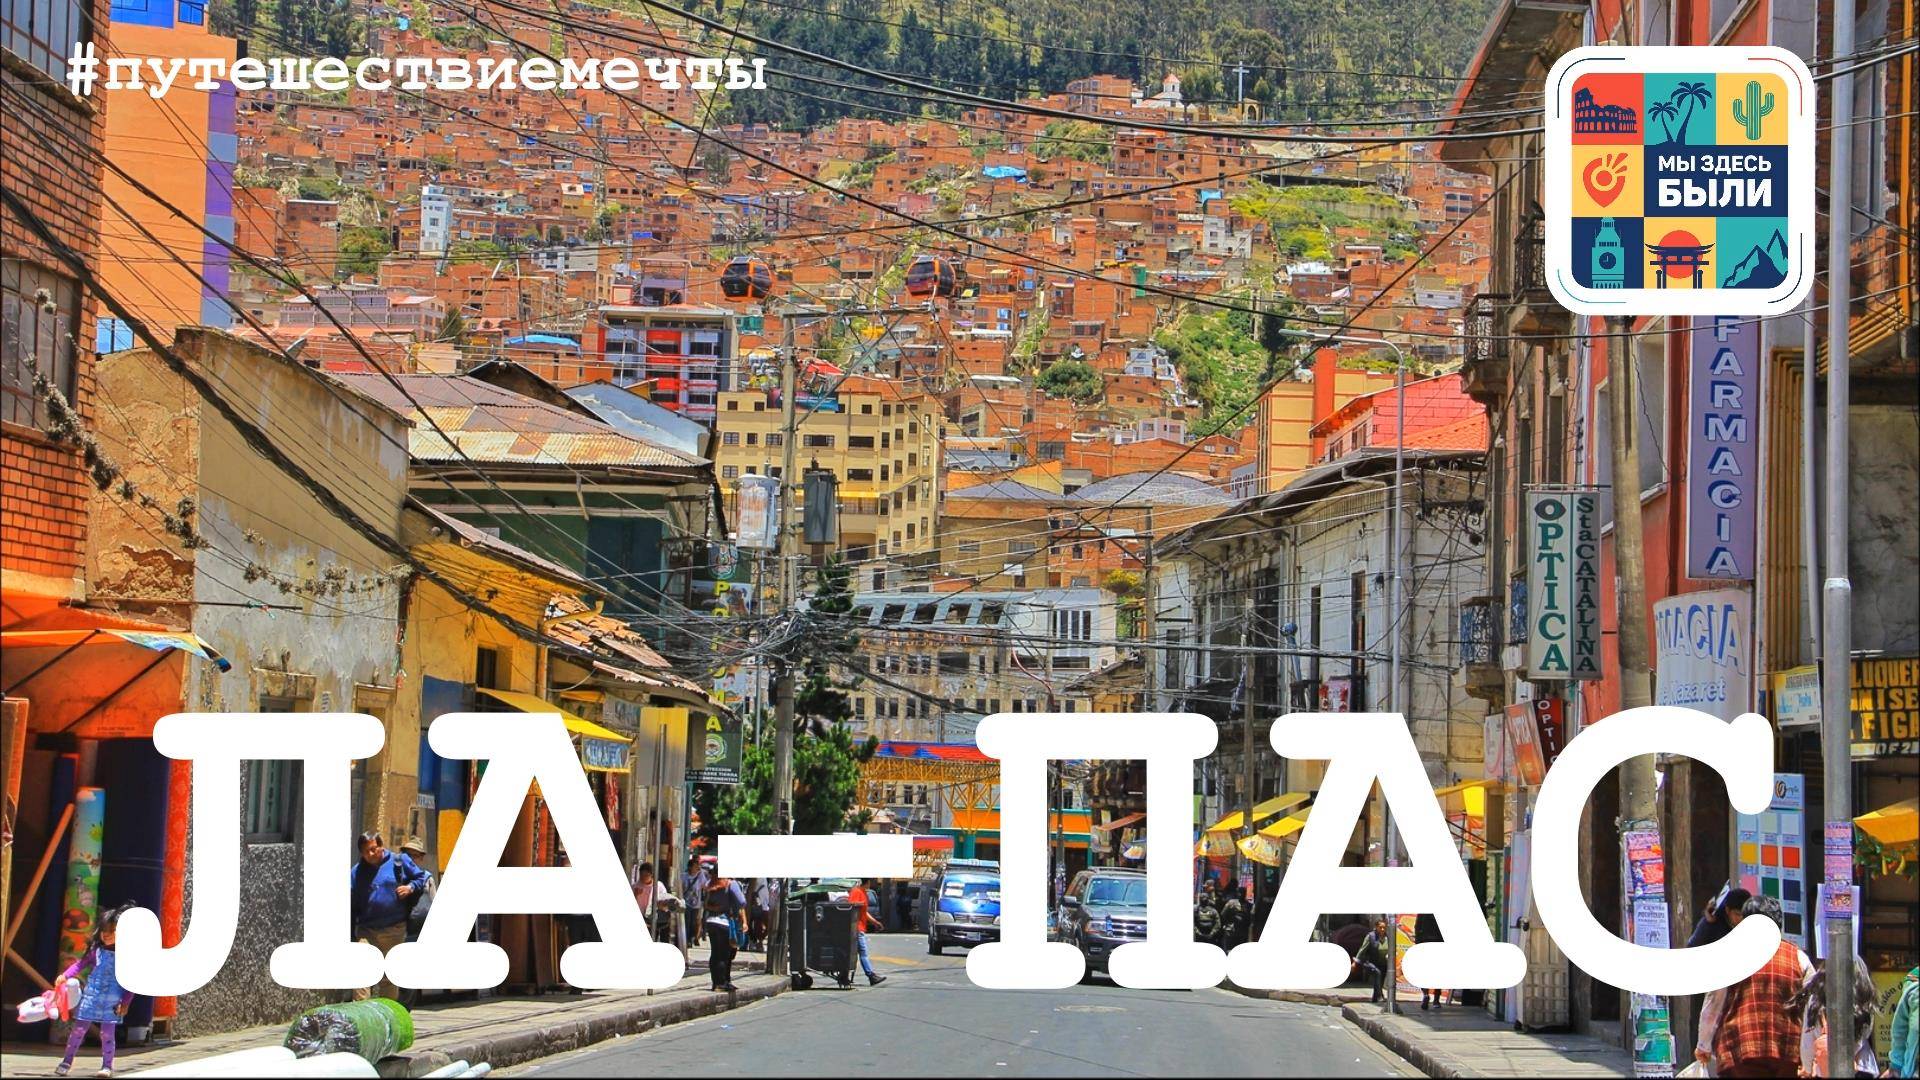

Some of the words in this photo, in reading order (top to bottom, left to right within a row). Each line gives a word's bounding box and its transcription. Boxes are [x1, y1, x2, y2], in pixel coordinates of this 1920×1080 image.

[1703, 316, 1748, 576] FARMACIA
[1534, 498, 1569, 672] OPTICA
[1655, 603, 1747, 677] MACIA
